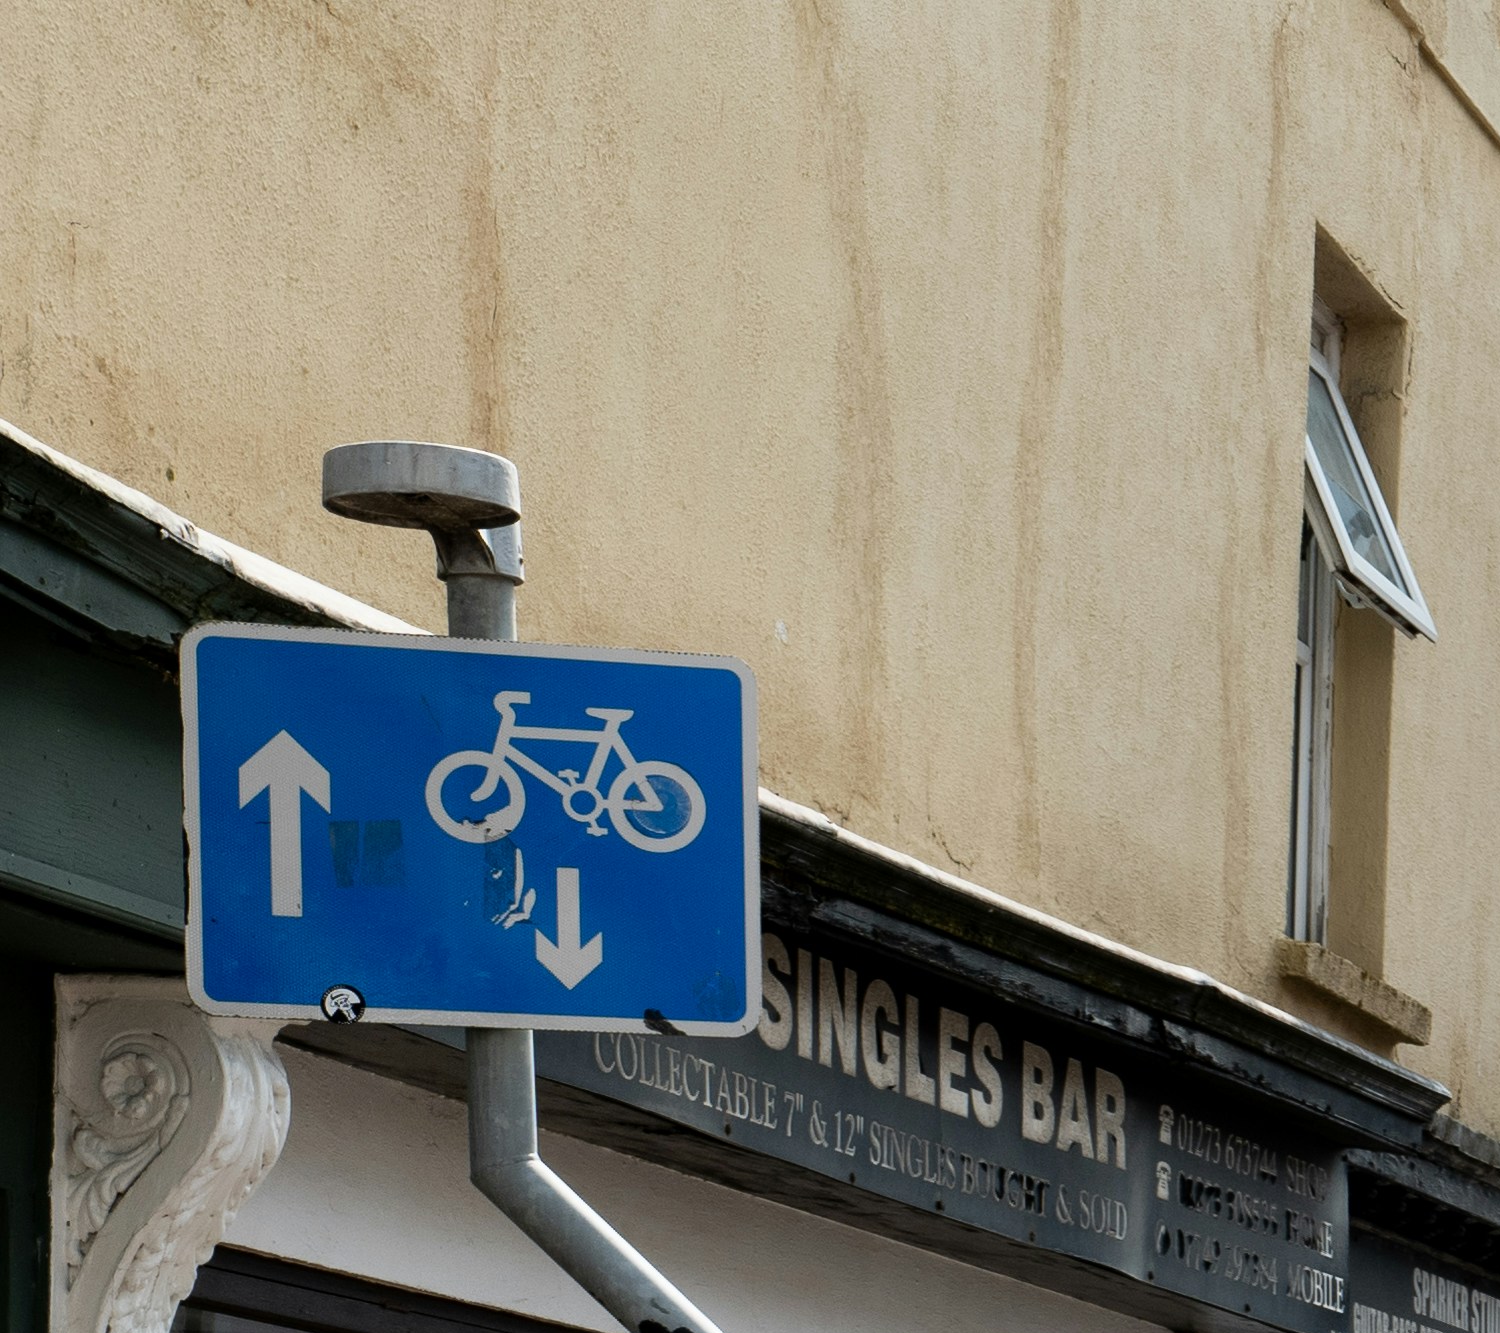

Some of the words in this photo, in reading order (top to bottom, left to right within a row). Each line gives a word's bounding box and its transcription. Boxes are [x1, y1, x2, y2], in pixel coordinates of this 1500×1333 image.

[757, 933, 1003, 1128] SINGLES
[1022, 1040, 1126, 1169] BAR
[594, 1032, 778, 1129] COLLECTABLE
[809, 1100, 828, 1147] &
[869, 1121, 956, 1190] SINGLES
[960, 1153, 1049, 1218] BOUGHT
[1056, 1184, 1074, 1225] &
[1079, 1190, 1127, 1240] SOLD
[1178, 1114, 1221, 1163] 01273
[1286, 1155, 1327, 1201] SHOP
[1286, 1261, 1344, 1314] MOBILE
[1413, 1267, 1469, 1331] SPARKER
